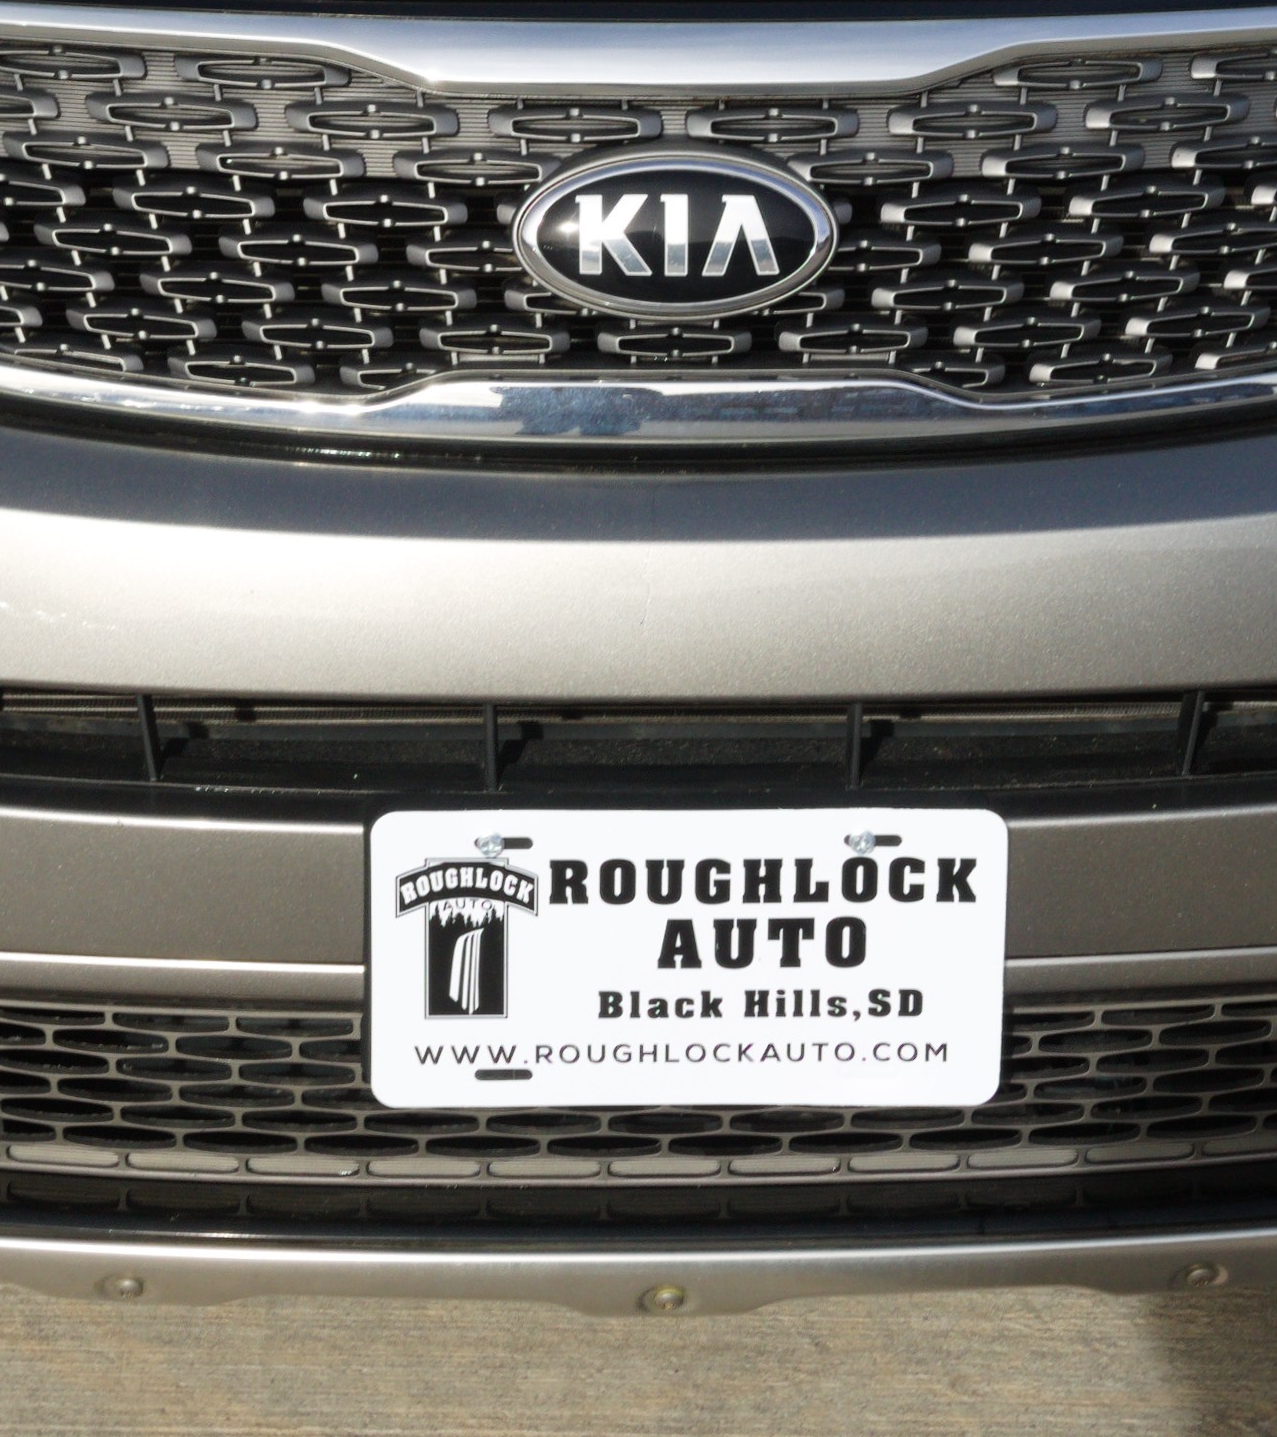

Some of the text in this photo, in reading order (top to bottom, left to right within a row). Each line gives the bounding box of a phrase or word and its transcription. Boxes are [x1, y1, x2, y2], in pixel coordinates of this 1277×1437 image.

[575, 193, 780, 277] KIA
[400, 866, 534, 905] ROUGHLOCK
[550, 857, 977, 905] ROUGHLOCK
[443, 898, 493, 912] AUTO
[658, 916, 867, 969] AUTO
[598, 989, 923, 1021] Black Hills,SD
[415, 1043, 948, 1065] WWW.ROUGHLOCKAUTO.COM
